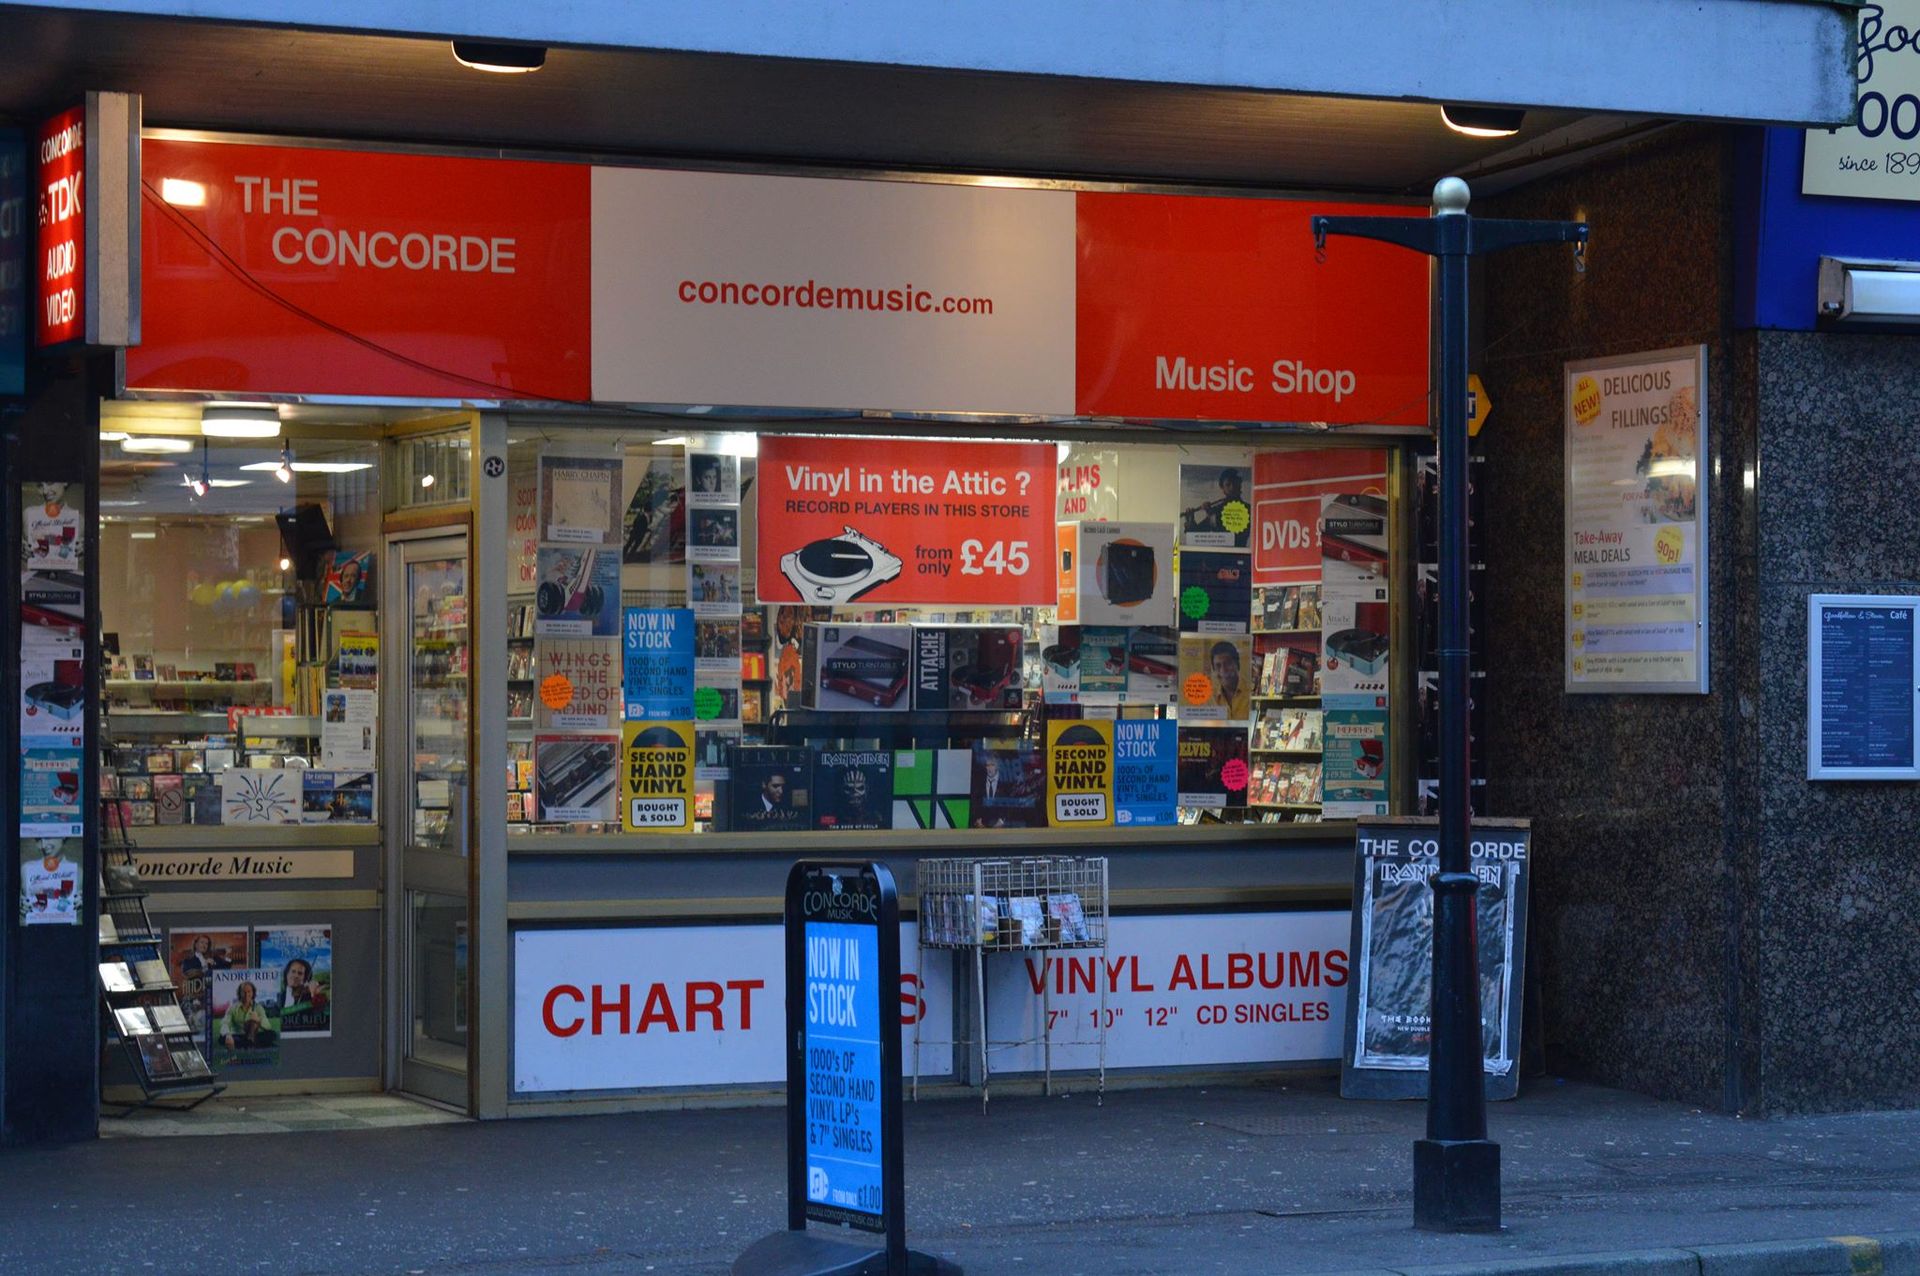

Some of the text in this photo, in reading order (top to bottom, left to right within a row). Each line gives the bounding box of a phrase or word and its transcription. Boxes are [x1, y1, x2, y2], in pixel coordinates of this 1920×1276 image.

[41, 122, 83, 164] CONCORDE
[1838, 155, 1878, 171] since
[48, 171, 82, 225] TDK
[234, 176, 318, 216] THE
[272, 227, 516, 274] CONCORDE
[47, 240, 76, 281] AUDIO
[678, 280, 993, 314] concordemusic.com
[47, 288, 76, 327] VIDEO
[1155, 356, 1356, 402] Music Shop
[1604, 370, 1671, 396] DELICIOUS
[1574, 391, 1600, 418] NEW!
[785, 466, 1031, 497] Vinyl in the Attic ?
[786, 501, 1030, 518] RECORD PLAYERS IN THIS STORE
[1064, 497, 1087, 515] AND
[1263, 519, 1310, 550] DVDs
[1574, 530, 1623, 545] Take-Away
[916, 539, 1030, 576] from £45
[1574, 548, 1631, 564] MEAL DEALS
[1657, 540, 1679, 563] 90p!
[918, 562, 952, 576] only
[628, 613, 676, 630] NOW IN
[1890, 609, 1908, 620] Café
[628, 631, 672, 648] STOCK
[549, 652, 611, 667] WINGS
[658, 656, 670, 666] OF
[831, 660, 857, 669] STYLO
[919, 631, 939, 691] ATTACHÉ
[575, 670, 607, 683] THE
[628, 666, 688, 677] SECOND HAND
[596, 687, 620, 701] OF
[649, 687, 684, 697] SINGLES
[554, 703, 608, 716] OUND
[1117, 723, 1160, 740] NOW IN
[630, 752, 687, 763] SECOND
[1054, 749, 1106, 760] SECOND
[1117, 741, 1157, 758] STOCK
[1178, 741, 1212, 758] ELVIS
[821, 752, 889, 766] IRON MAIDEN
[1054, 761, 1106, 774] HAND
[630, 764, 687, 778] HAND
[1144, 764, 1154, 773] OF
[629, 779, 687, 794] VINYL
[1053, 775, 1106, 790] VINYL
[1117, 774, 1171, 783] SECOND HAND
[1061, 798, 1100, 807] BOUGHT
[1135, 792, 1168, 802] SINGLES
[637, 803, 679, 812] BOUGHT
[1074, 808, 1098, 816] SOLD
[640, 813, 677, 822] & SOLD
[1360, 838, 1526, 859] THE COORDE
[229, 855, 293, 874] Music
[1380, 862, 1428, 887] IRON
[803, 890, 878, 921] CONCORDE
[826, 908, 853, 920] MUSIC
[808, 936, 860, 981] NOW IN
[255, 970, 279, 982] RIEU
[1024, 949, 1349, 995] VINYL ALBUMS
[542, 979, 764, 1038] CHART
[809, 982, 857, 1028] STOCK
[1048, 1001, 1330, 1030] 7" 10" 12" CD SINGLES
[1380, 1015, 1402, 1024] THE
[809, 1048, 855, 1074] 1000's OF
[809, 1072, 875, 1102] SECOND HAND
[809, 1097, 860, 1126] VINYL LP's
[810, 1123, 873, 1154] & 7" SINGLES
[857, 1184, 881, 1210] £1.00
